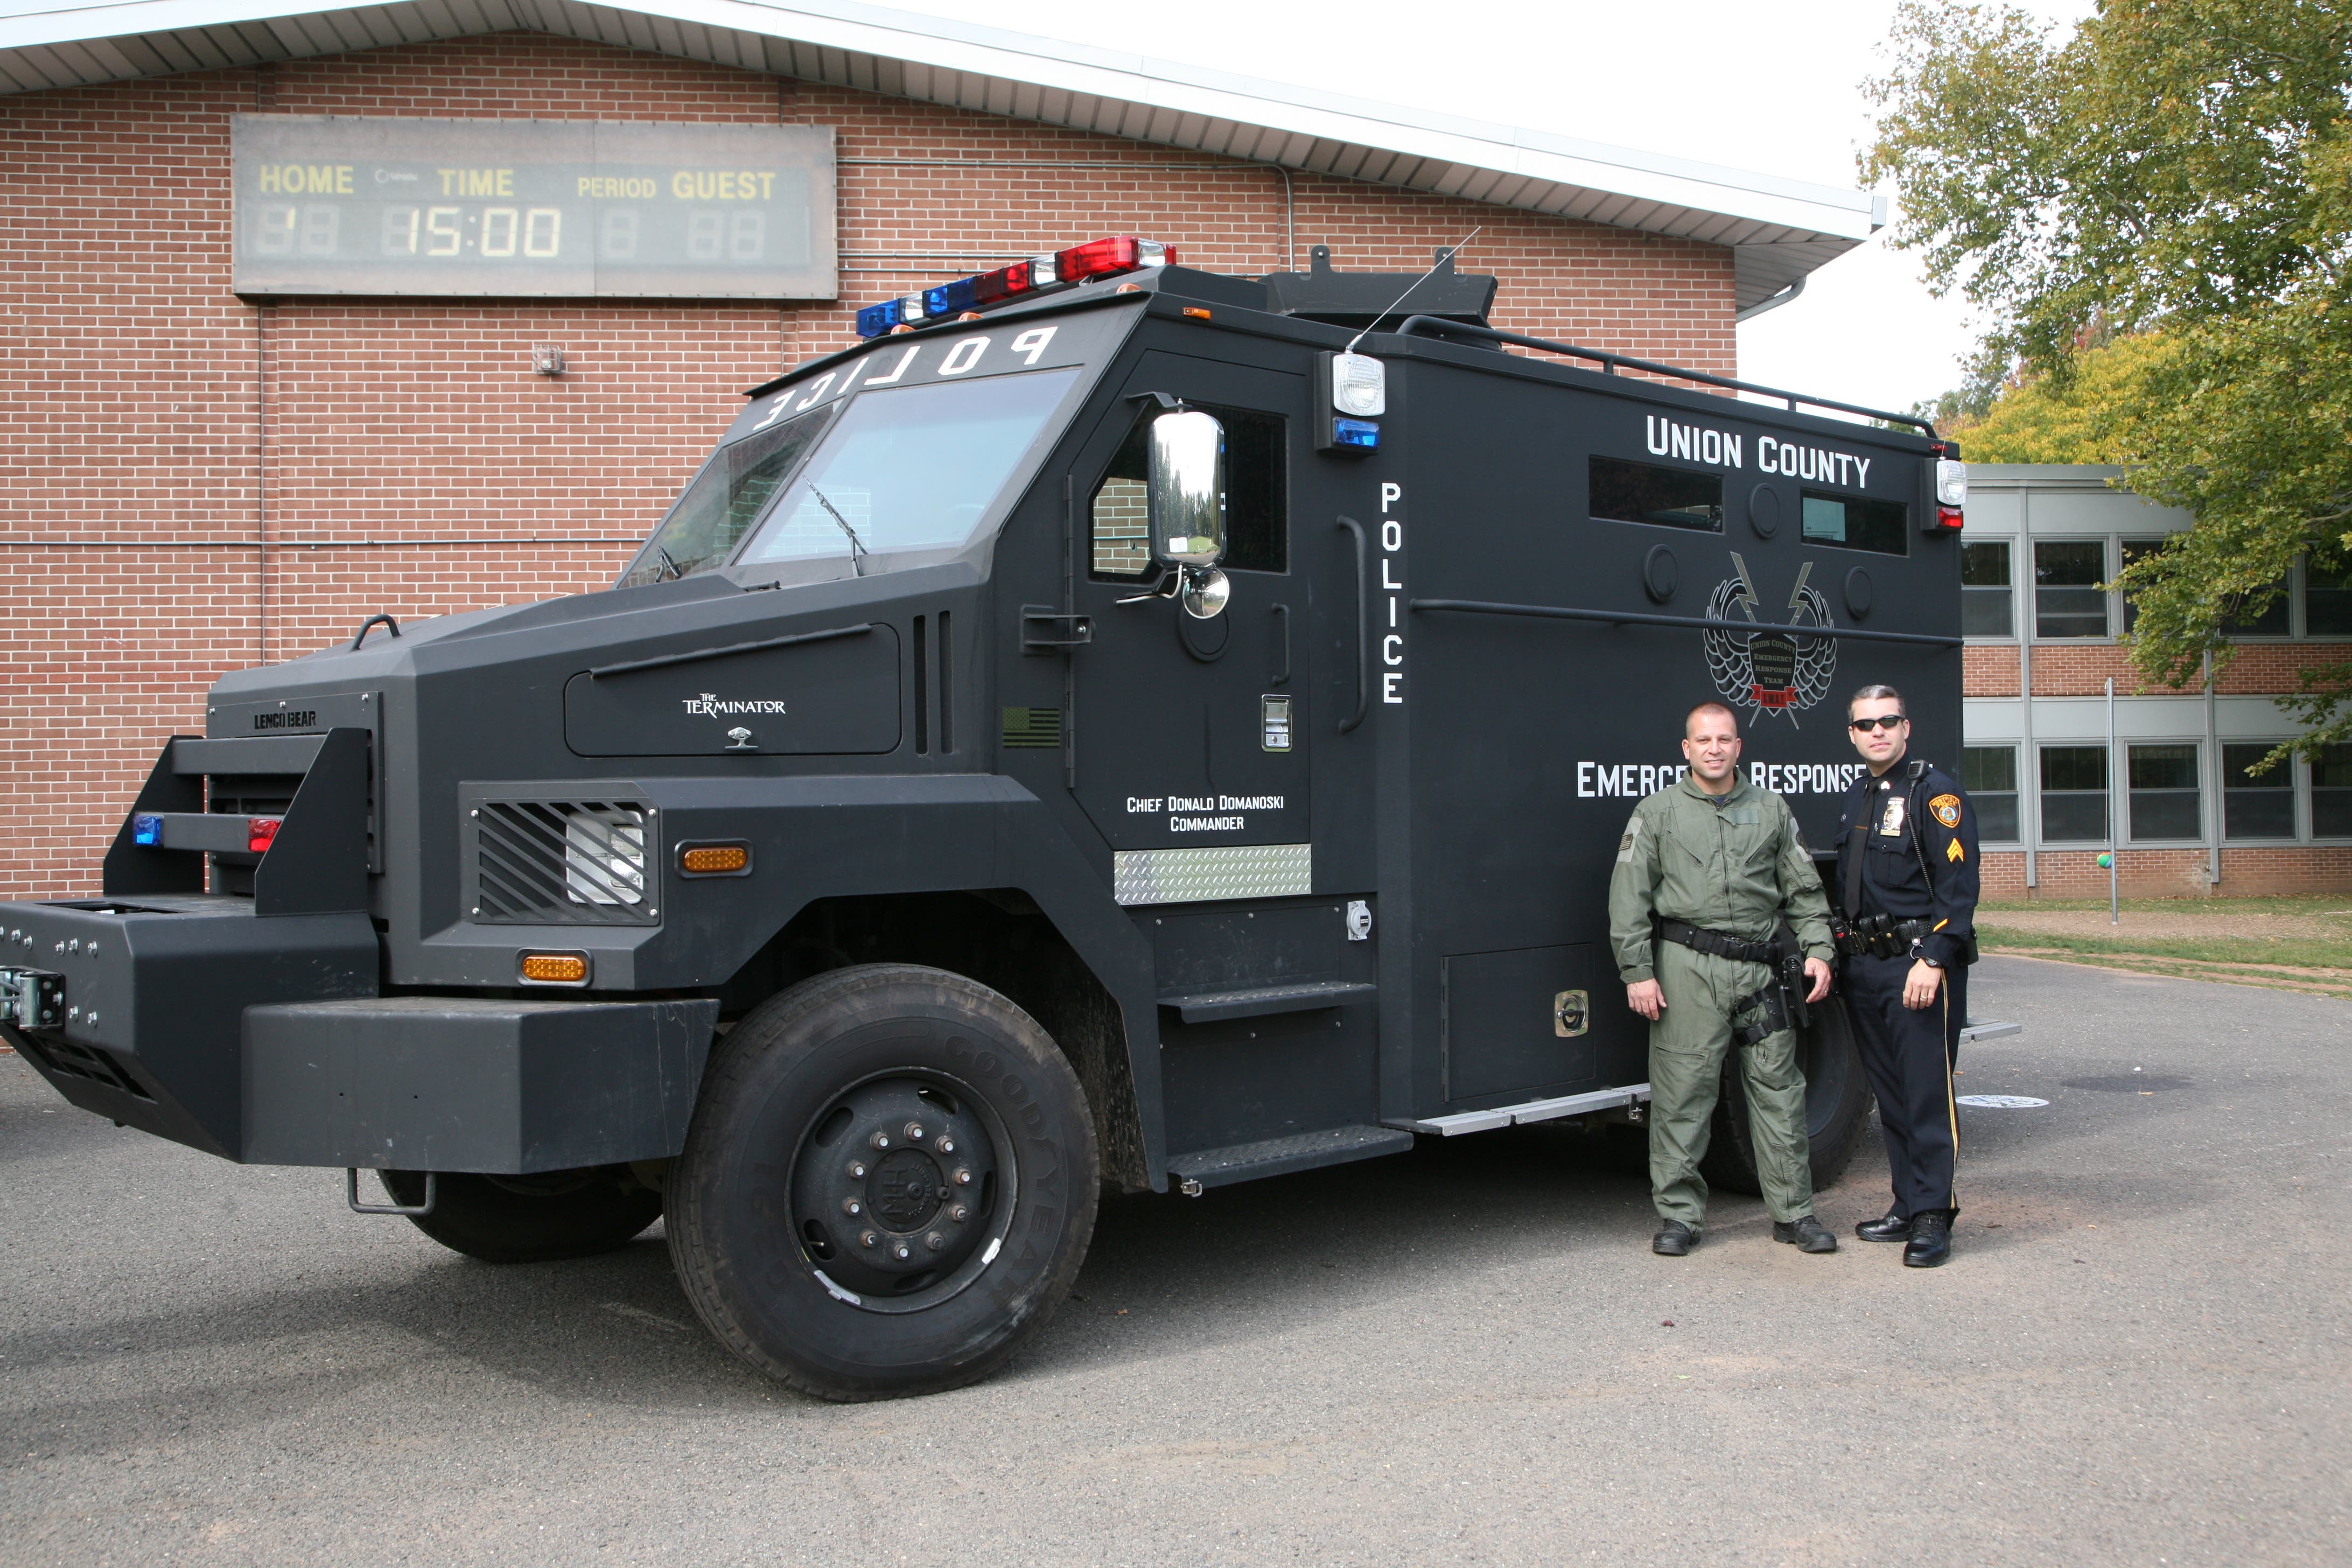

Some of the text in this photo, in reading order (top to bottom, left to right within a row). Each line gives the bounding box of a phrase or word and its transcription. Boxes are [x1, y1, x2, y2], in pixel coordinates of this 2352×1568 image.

[260, 164, 354, 194] HOME
[437, 169, 514, 197] TIME
[577, 177, 656, 199] PERIOD
[673, 171, 776, 201] GUEST
[409, 207, 561, 257] 15:00
[1647, 415, 1871, 488] UNION COUNTY
[1382, 482, 1402, 703] POLICE
[1751, 639, 1796, 654] UNION COUNTY
[1754, 653, 1793, 662] EMERGENCY
[1755, 665, 1792, 674] RESPONSE
[1763, 676, 1783, 684] TEAM
[699, 693, 717, 702] THE
[682, 700, 786, 719] TERMINATOR
[255, 711, 317, 730] LENCO BEAR
[1127, 795, 1284, 813] CHIEF DONALD DOMANOSKI
[1171, 816, 1244, 831] COMMANDER
